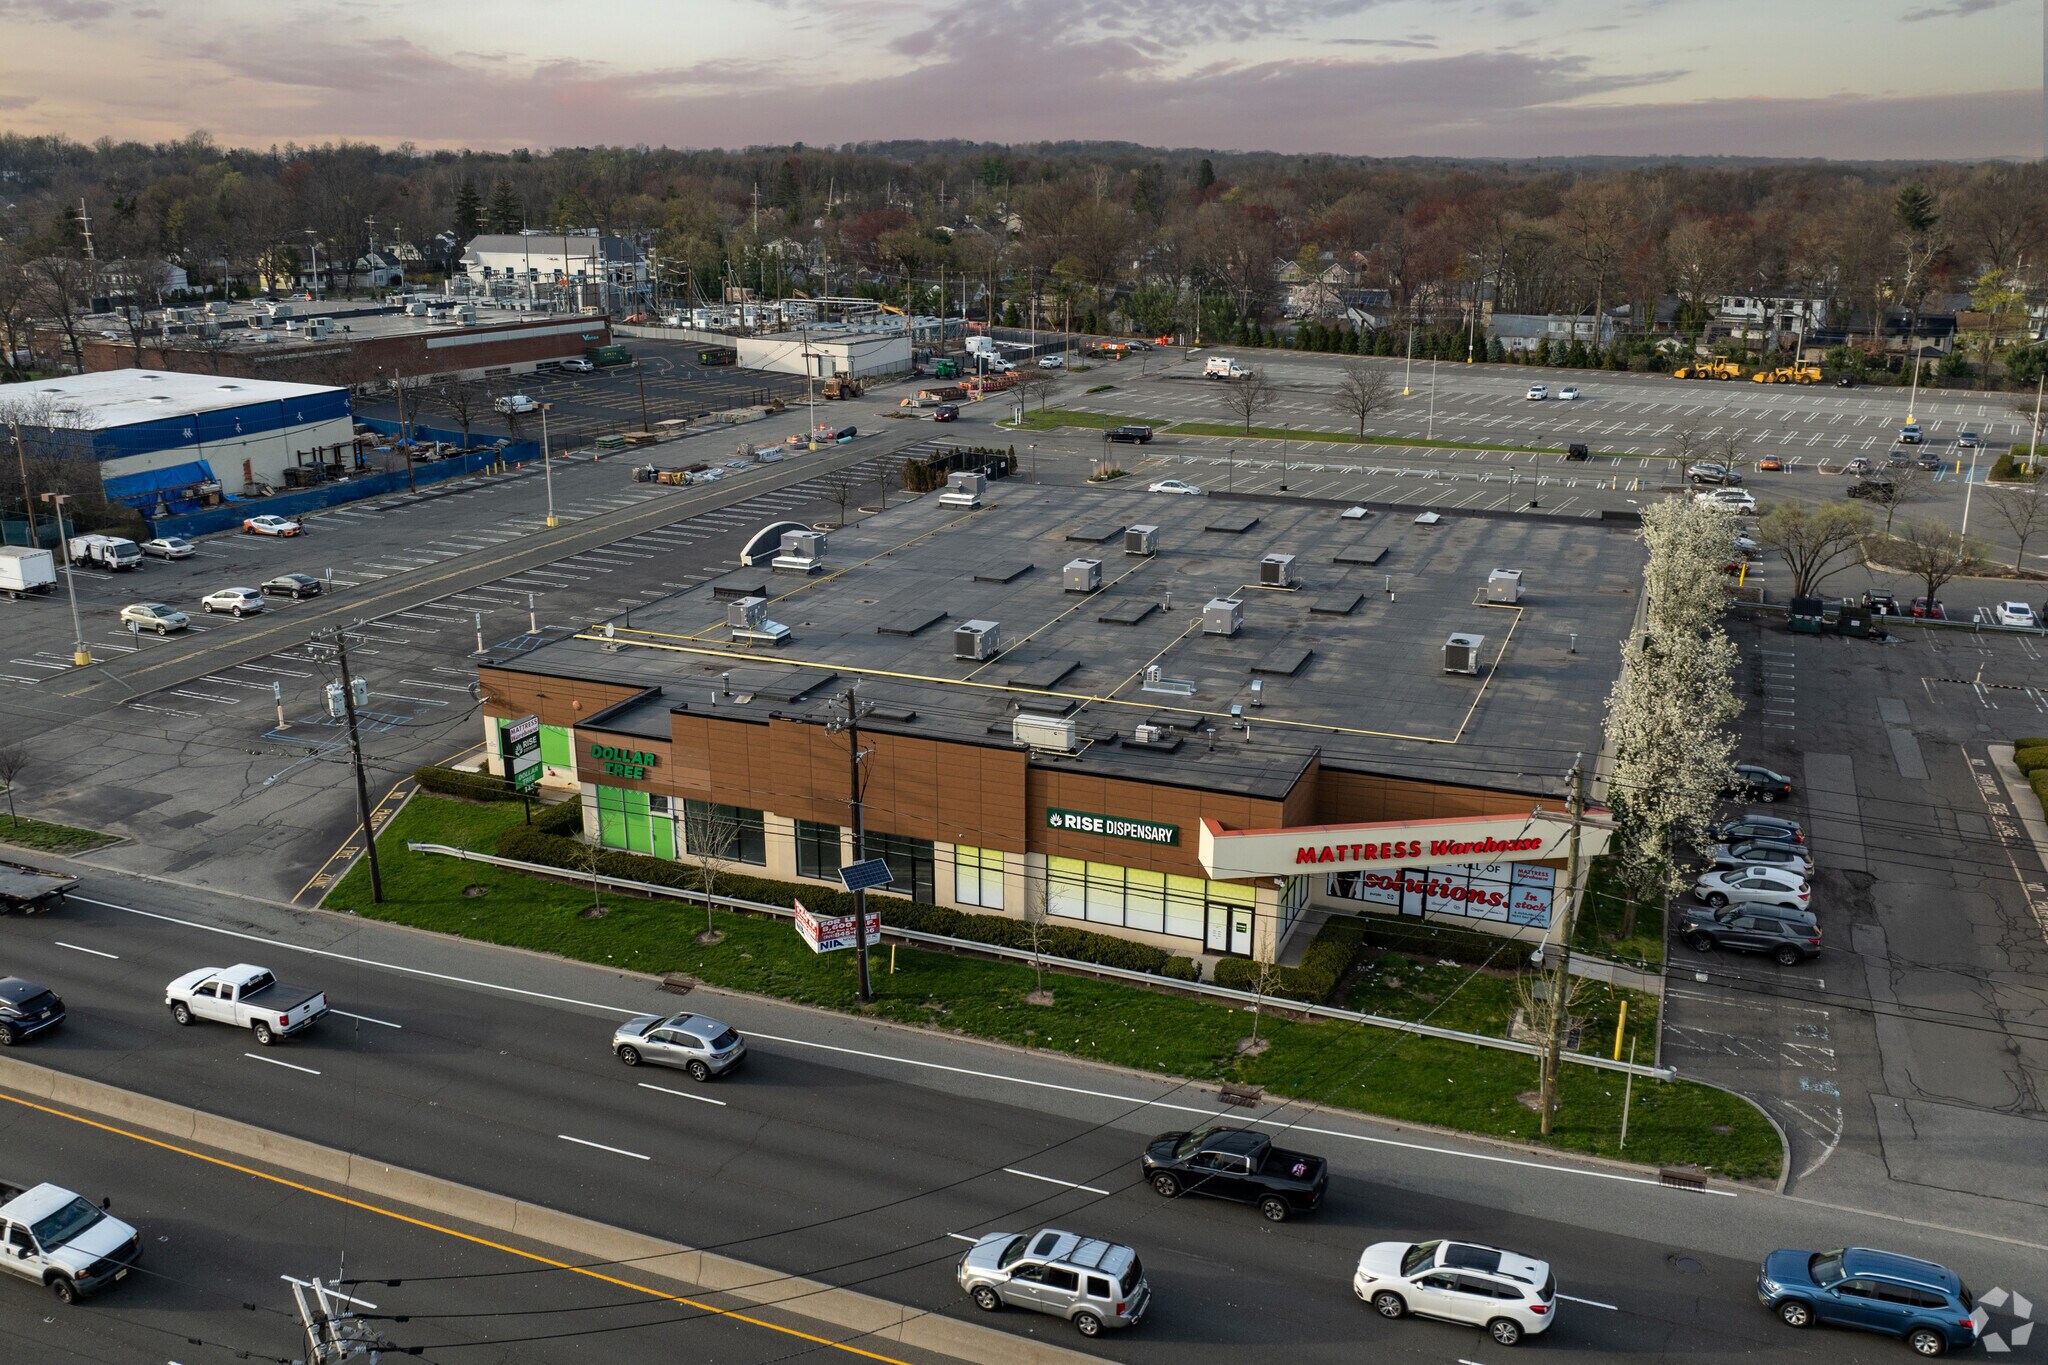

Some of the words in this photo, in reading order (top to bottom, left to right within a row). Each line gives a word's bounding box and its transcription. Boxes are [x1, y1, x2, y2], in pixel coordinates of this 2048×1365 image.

[510, 718, 538, 734] MATTRESS
[523, 736, 537, 748] RISE
[591, 745, 656, 766] DOLLAR
[519, 766, 539, 780] DOLLAR
[603, 762, 644, 780] TREE
[522, 774, 535, 785] TREE
[1064, 814, 1104, 832] RISE
[1106, 820, 1173, 843] DISPENSARY
[1296, 840, 1421, 864] MATTRESS
[1430, 837, 1543, 856] Warehouse
[1486, 864, 1501, 873] OF
[1517, 869, 1549, 877] MATTRESS
[1364, 870, 1509, 908] solutions.
[1524, 892, 1538, 901] In
[1515, 901, 1546, 912] stock
[820, 919, 841, 927] FOR
[844, 914, 877, 923] LESE
[822, 922, 852, 932] 8,600
[820, 940, 844, 950] NIA
